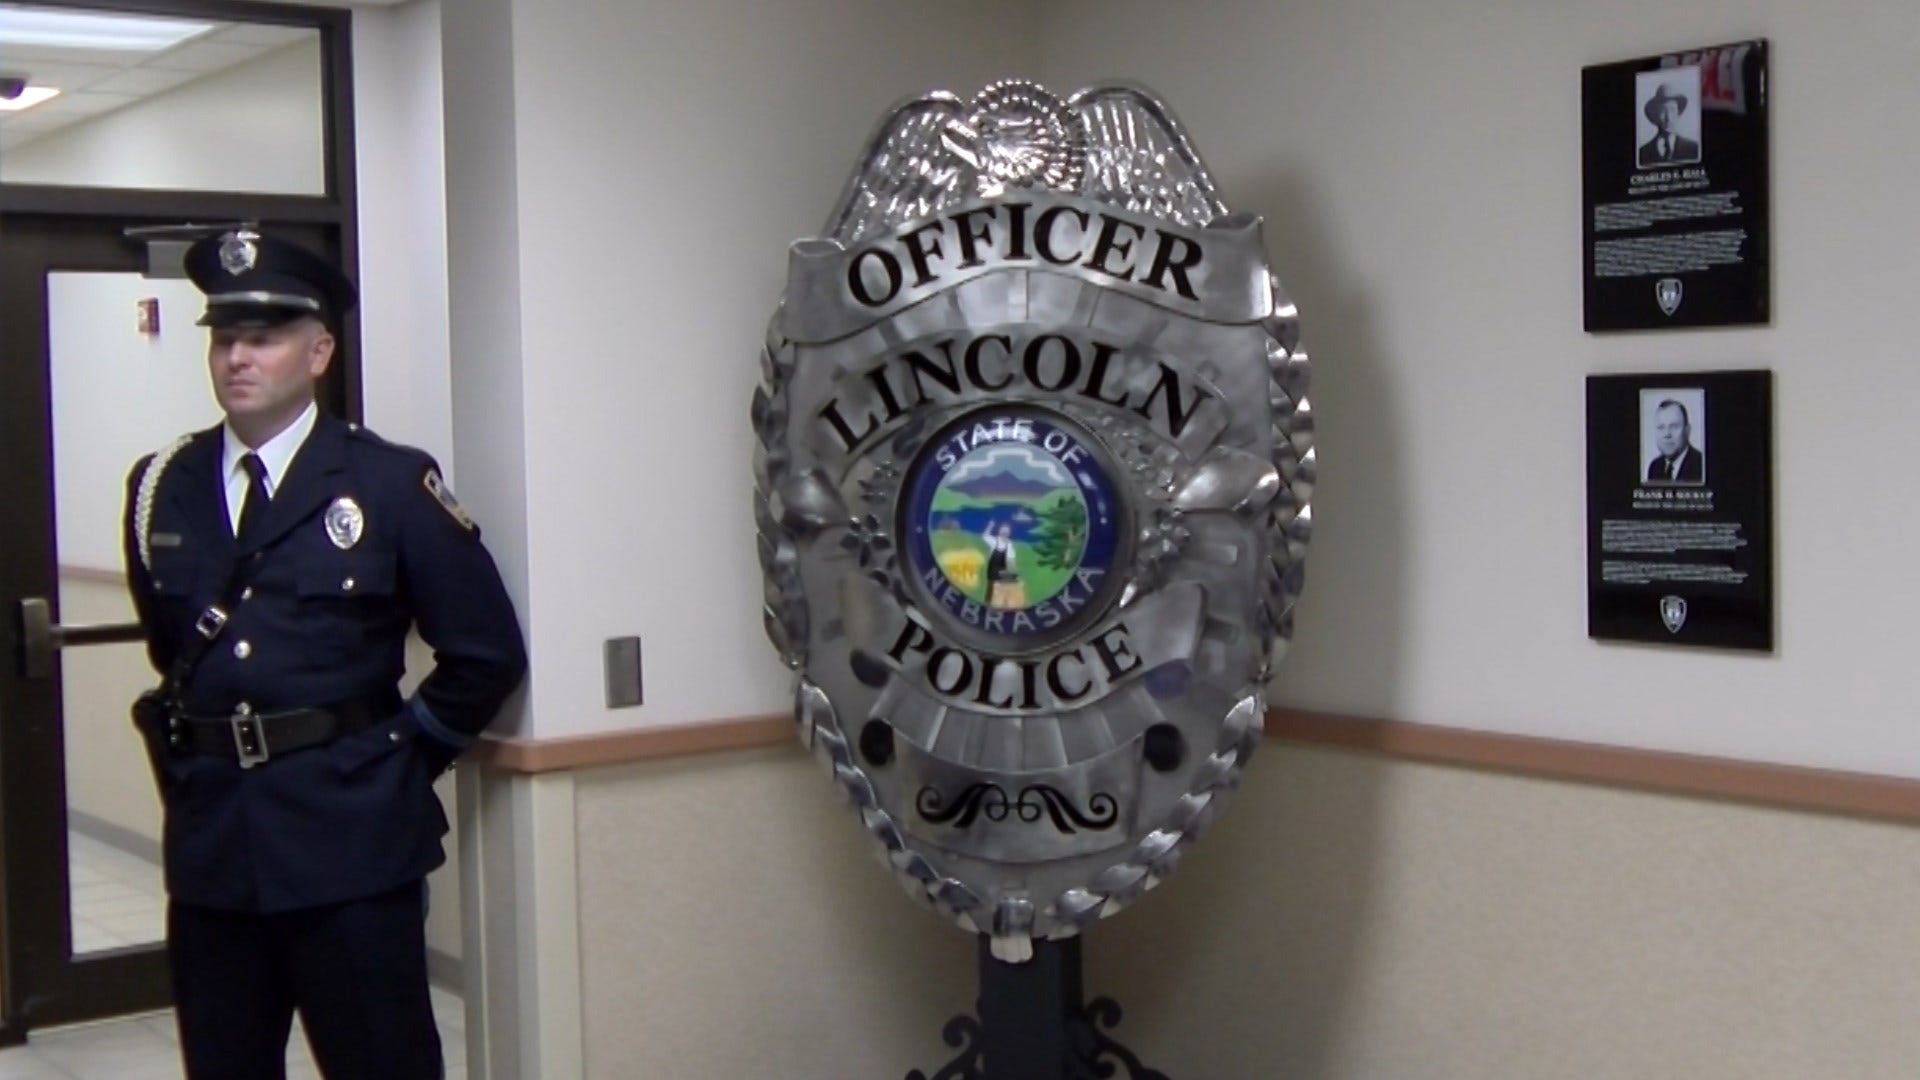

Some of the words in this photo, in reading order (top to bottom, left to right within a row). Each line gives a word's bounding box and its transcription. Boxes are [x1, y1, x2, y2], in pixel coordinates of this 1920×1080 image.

[847, 202, 1203, 307] OFFICER
[818, 333, 1214, 453] LINCOLN
[935, 416, 1035, 472] STATE
[1043, 431, 1089, 468] OF
[924, 566, 1105, 634] NEBRASKA
[886, 621, 1144, 709] POLICE
